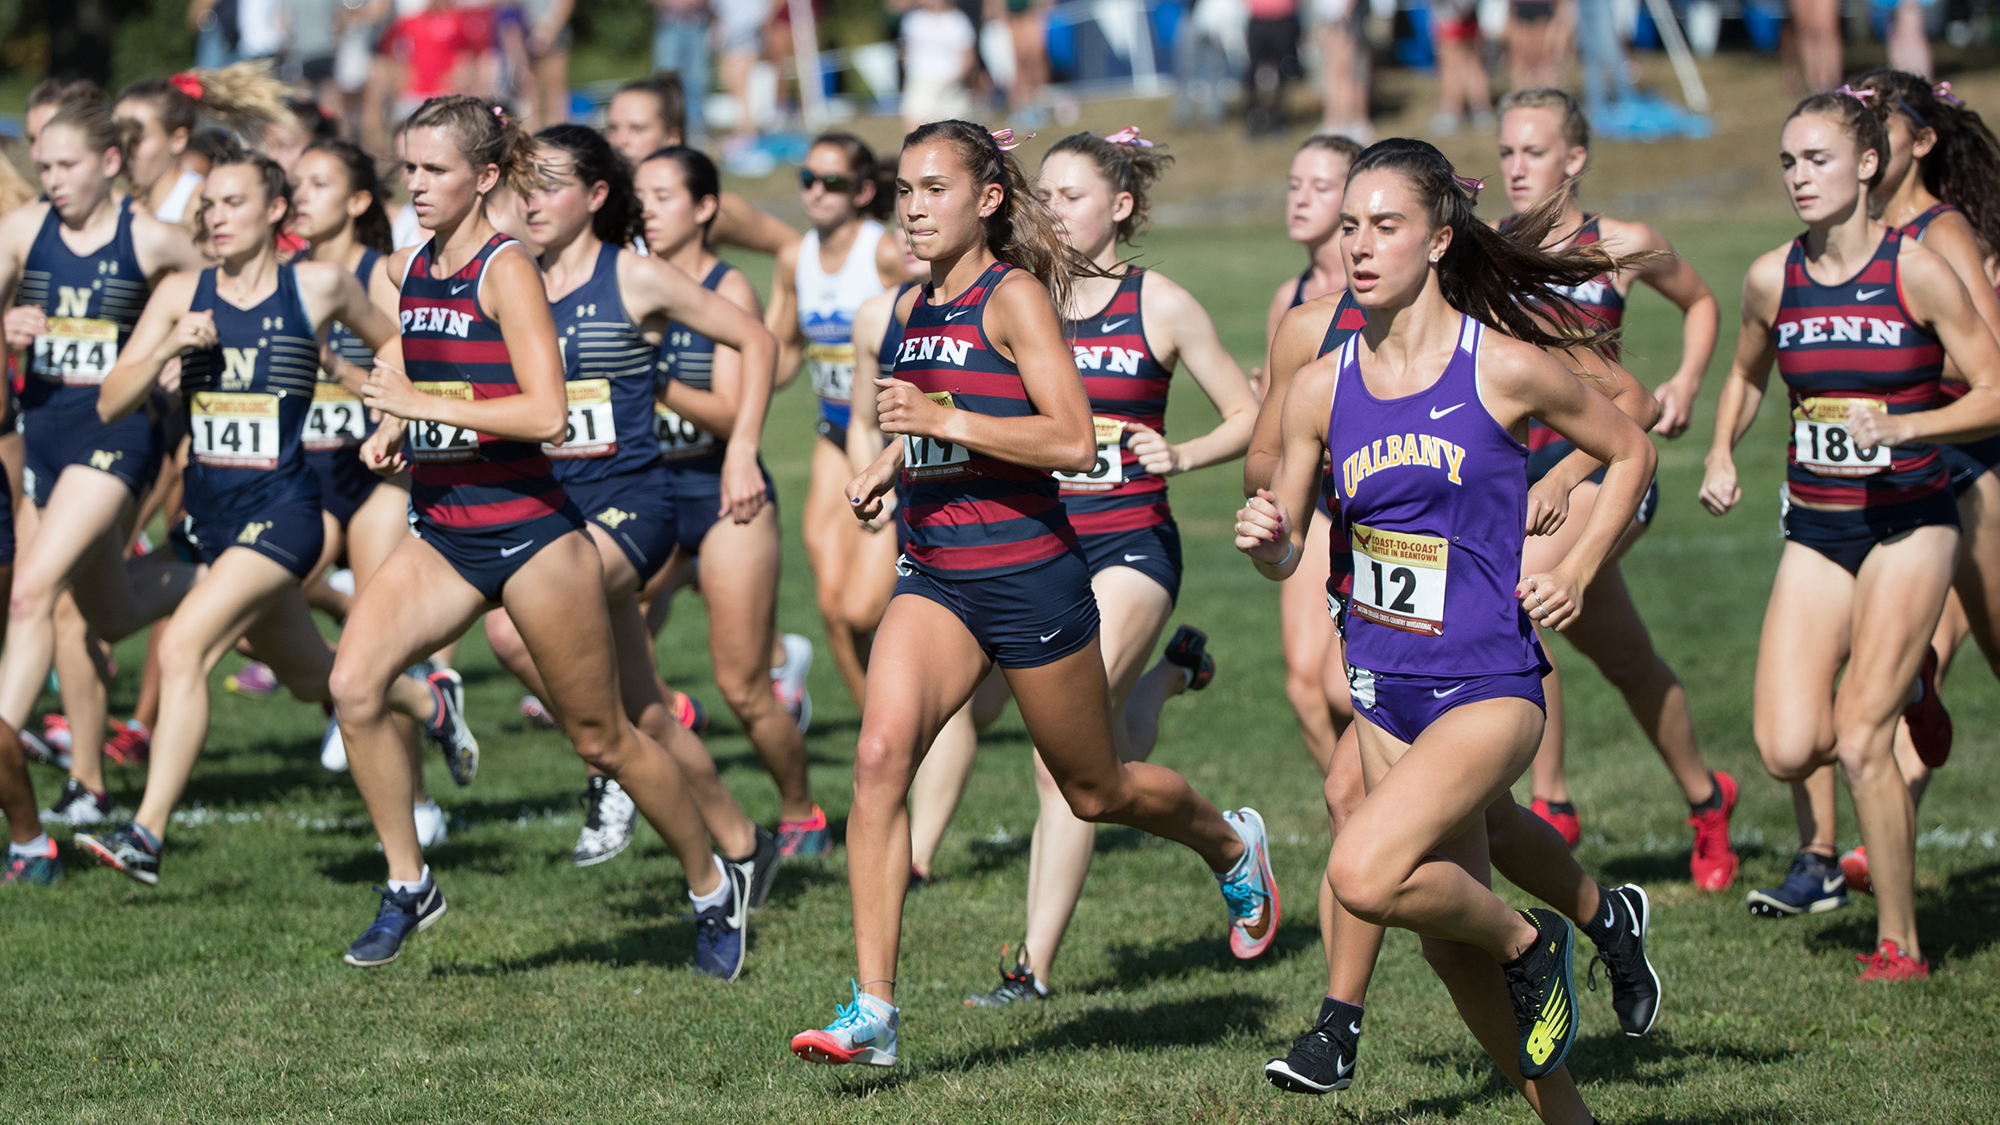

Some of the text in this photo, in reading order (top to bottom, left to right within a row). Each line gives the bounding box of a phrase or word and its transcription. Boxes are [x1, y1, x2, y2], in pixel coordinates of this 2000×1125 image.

[401, 307, 474, 338] PENN
[1778, 316, 1905, 348] PENN
[46, 342, 105, 371] 144
[1073, 346, 1144, 376] NN
[310, 407, 351, 434] 42
[659, 419, 700, 446] 40
[203, 421, 260, 452] 141
[1343, 433, 1466, 498] UALBANY
[1371, 535, 1438, 554] COAST-TO-COAST
[1371, 544, 1438, 563] BATTLE IN BEANTOWN
[1371, 561, 1417, 614] 12
